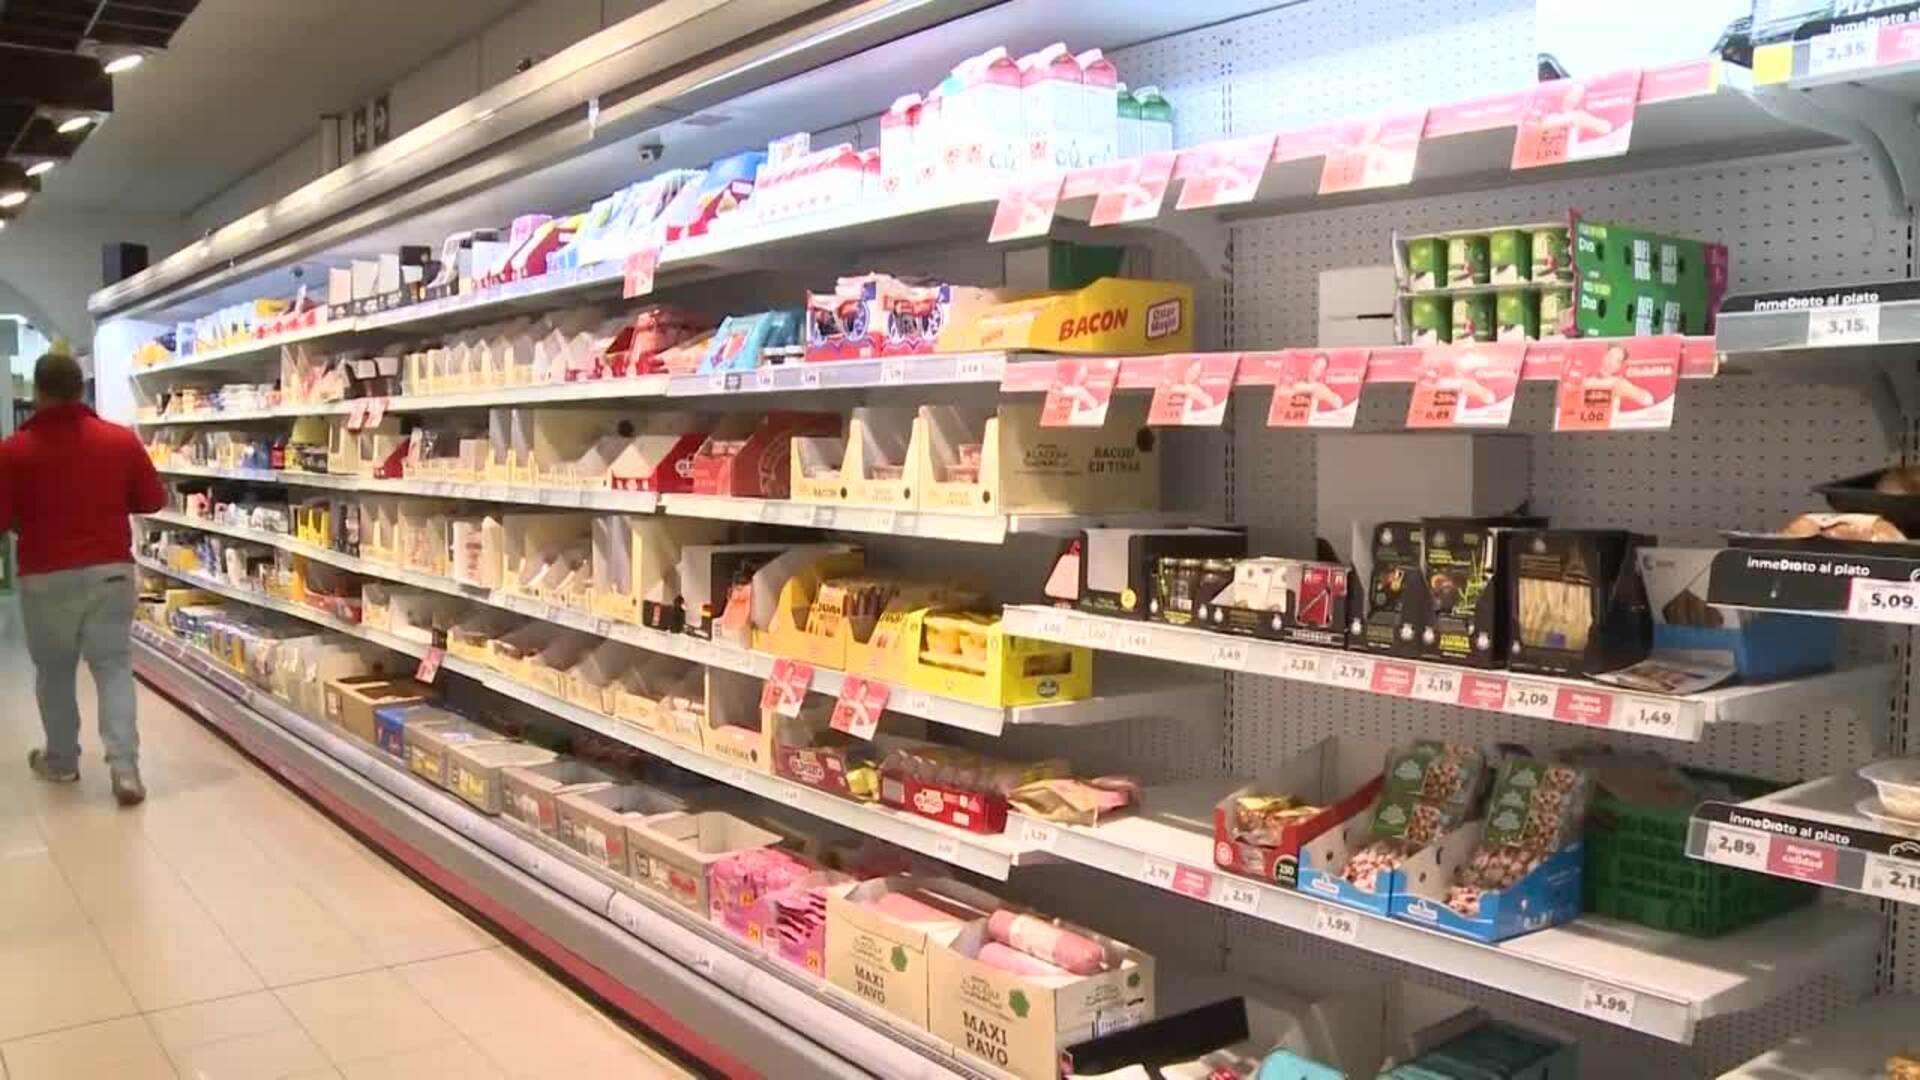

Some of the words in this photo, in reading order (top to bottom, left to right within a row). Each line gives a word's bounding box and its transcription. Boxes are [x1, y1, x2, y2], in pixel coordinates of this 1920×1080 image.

[1827, 293, 1839, 305] al
[1842, 291, 1880, 306] plato
[1058, 308, 1129, 342] BACON
[1828, 319, 1865, 334] 3,15
[1818, 560, 1832, 574] al
[1834, 563, 1871, 577] plato
[1871, 593, 1914, 609] 5,09
[1517, 691, 1549, 706] 2,09
[1640, 708, 1672, 725] 1,49
[1800, 826, 1812, 839] al
[1815, 829, 1850, 845] plato
[1718, 836, 1756, 854] 2,89
[854, 964, 884, 989] MAXI
[856, 981, 886, 1004] PAVO
[962, 1010, 1007, 1047] MAXI
[966, 1031, 1009, 1066] PAVO
